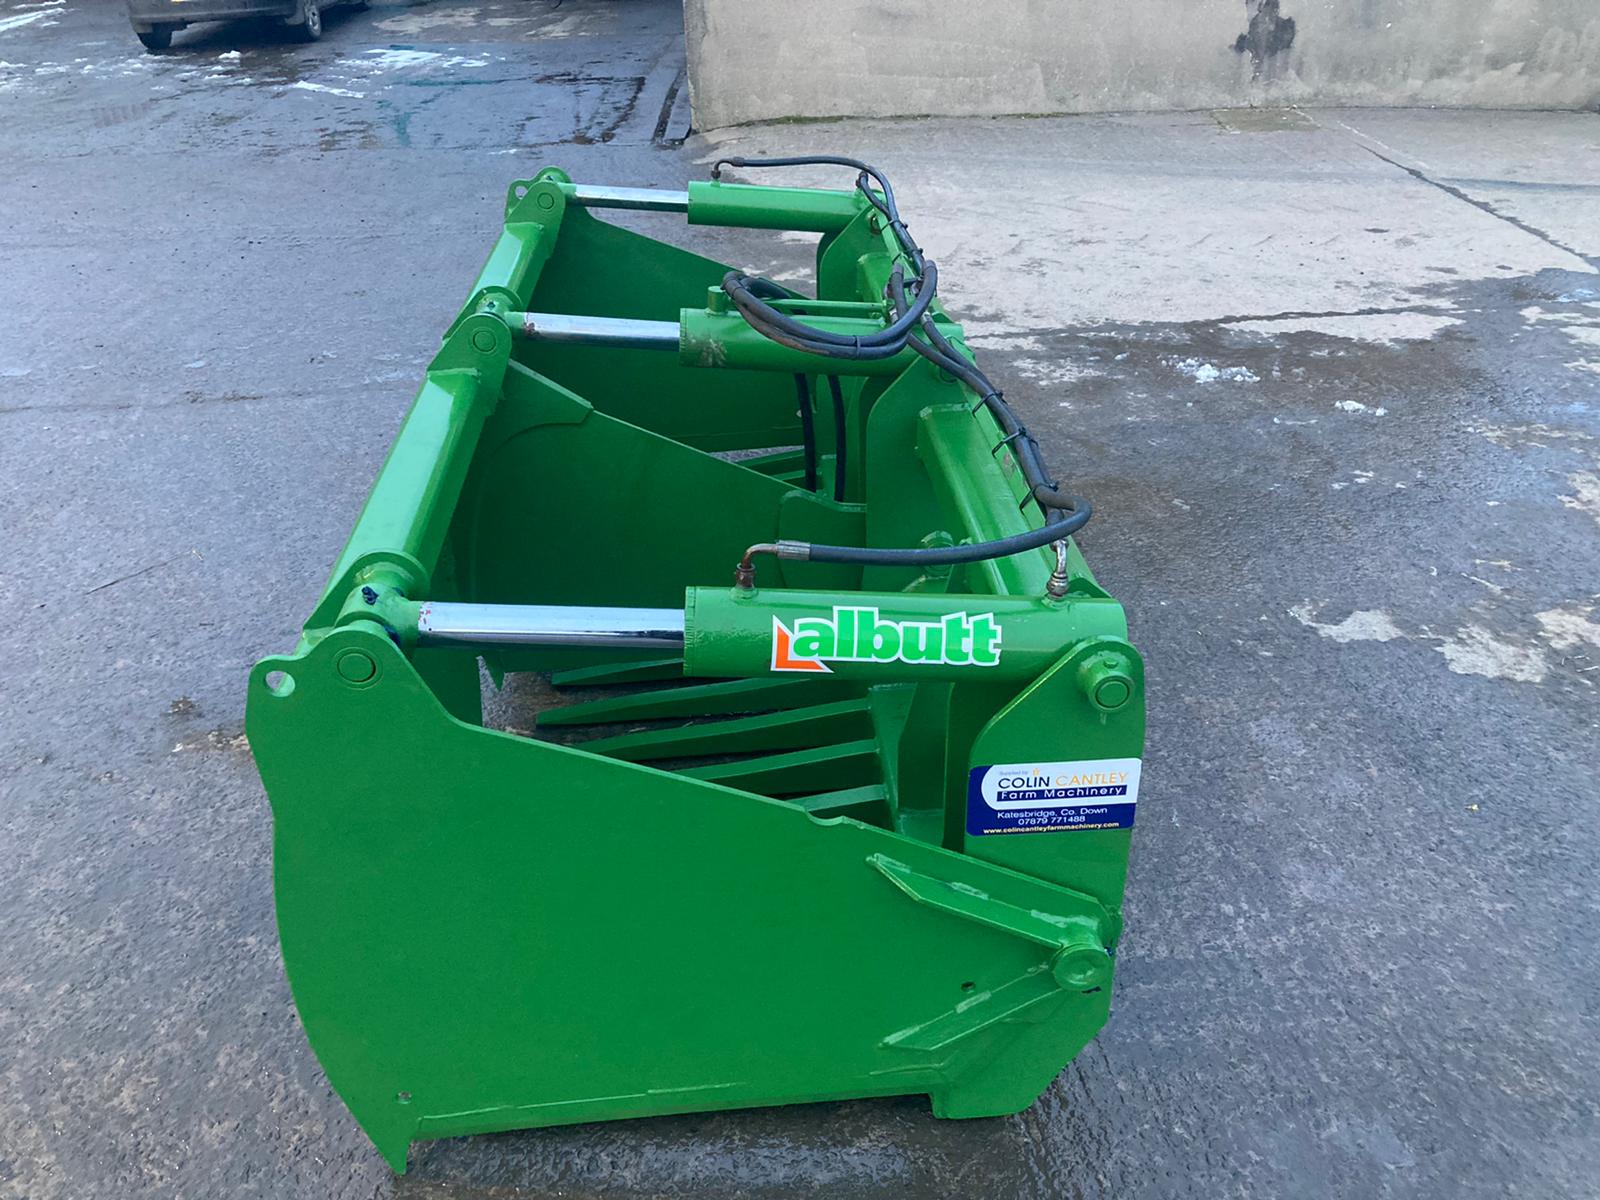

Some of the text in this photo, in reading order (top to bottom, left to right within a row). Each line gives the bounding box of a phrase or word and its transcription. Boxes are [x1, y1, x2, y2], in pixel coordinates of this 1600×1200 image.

[793, 609, 998, 663] albutt
[998, 772, 1128, 789] COLIN CANTLEY
[1001, 786, 1122, 800] Farm Machinery
[997, 807, 1108, 819] Katesbridge, Co. Down
[1018, 816, 1086, 825] 07879 771488
[983, 822, 1120, 834] www.colincantleyfarmmachinery.com
